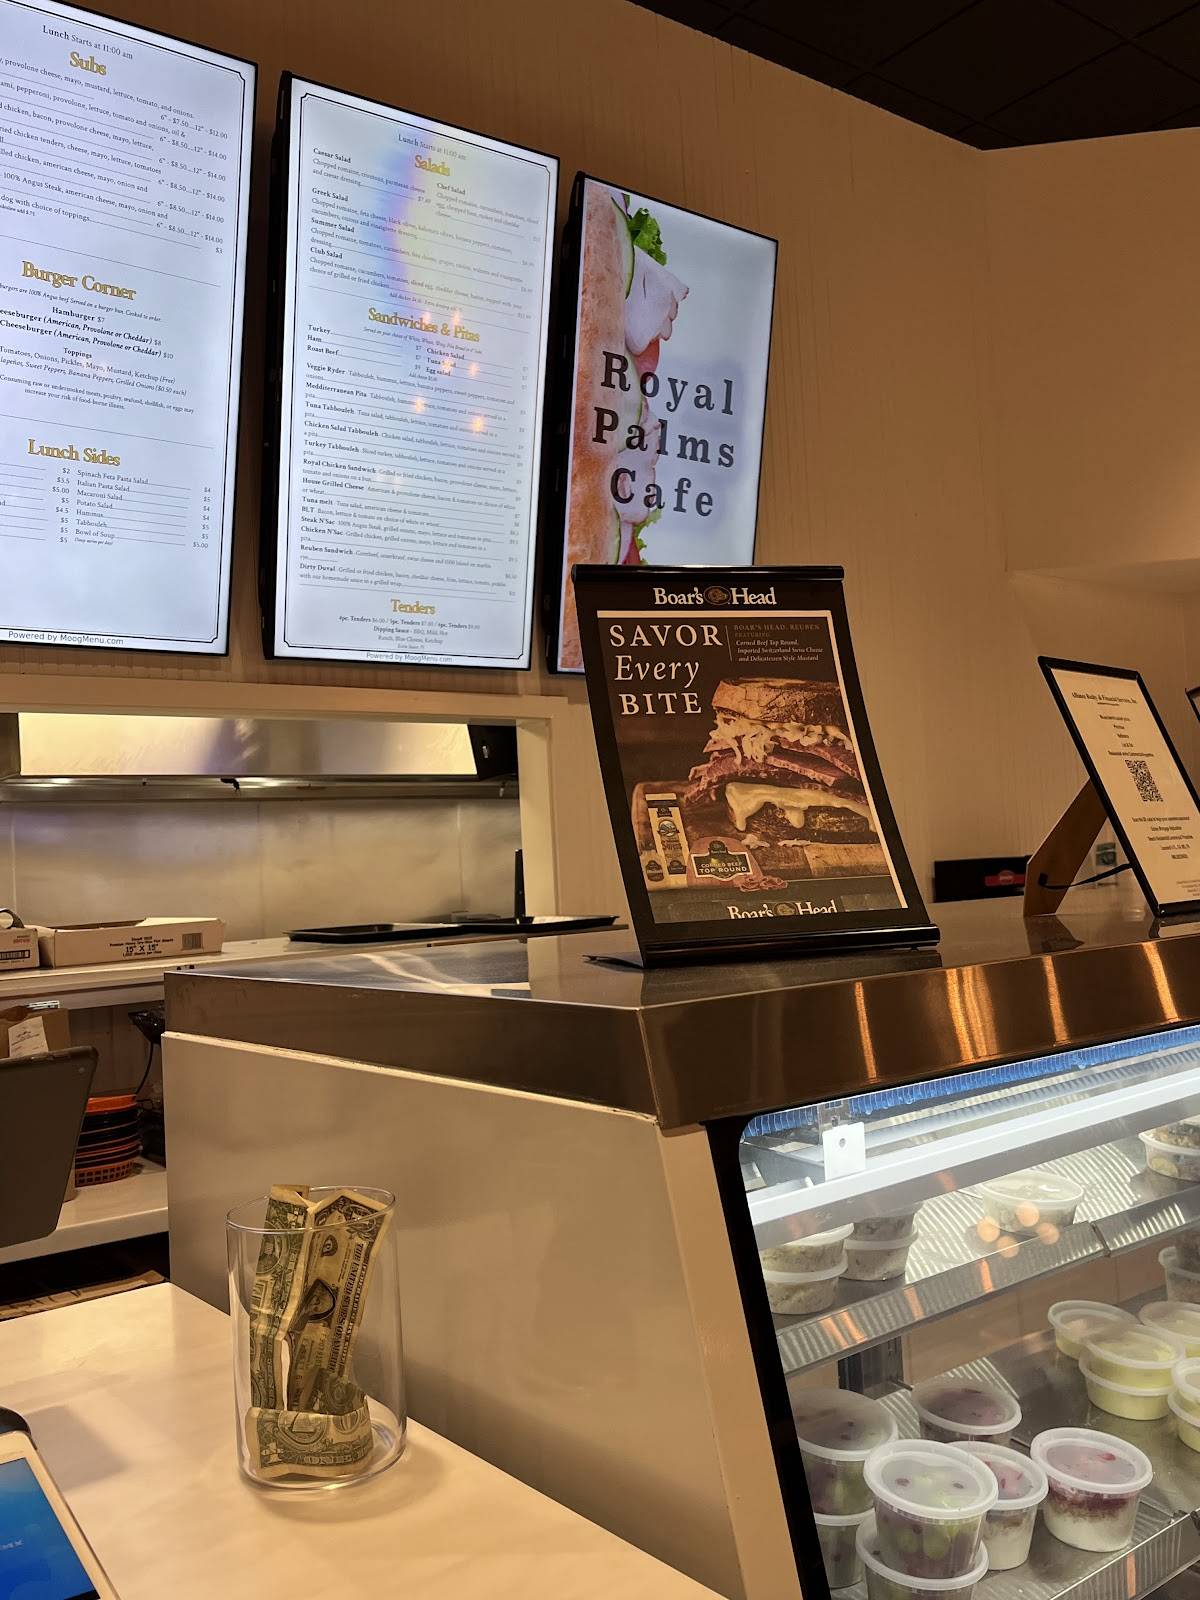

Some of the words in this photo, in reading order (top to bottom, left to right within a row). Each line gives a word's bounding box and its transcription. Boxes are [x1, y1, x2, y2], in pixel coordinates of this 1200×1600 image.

[42, 25, 69, 40] Lunch
[71, 34, 92, 47] Starts
[102, 44, 121, 56] 11:00
[4, 58, 38, 73] provolone
[69, 49, 107, 76] Subs
[55, 118, 88, 132] provolone
[398, 134, 419, 146] Lunch
[13, 129, 39, 141] chicken
[134, 162, 161, 174] tomatoes
[313, 147, 334, 158] Caesar
[334, 153, 352, 163] Salad
[414, 153, 451, 177] Salads
[43, 160, 72, 172] american
[117, 180, 135, 189] onion
[22, 176, 42, 187] Angus
[65, 189, 94, 200] american
[138, 207, 156, 216] onion
[312, 187, 331, 197] Greek
[332, 192, 349, 202] Salad
[1, 194, 15, 205] dog
[15, 199, 31, 207] with
[31, 202, 53, 212] choice
[310, 216, 338, 228] Summer
[338, 223, 355, 233] Salad
[310, 246, 326, 255] Club
[326, 250, 342, 259] Salad
[21, 260, 78, 289] Burger
[81, 274, 137, 301] Corner
[52, 307, 95, 321] Hamburger
[42, 316, 81, 331] (American,
[82, 324, 114, 336] Provolone
[122, 332, 152, 345] Cheddar)
[307, 324, 331, 335] Turkey
[368, 306, 438, 334] Sandwiches
[440, 322, 450, 336] &
[453, 324, 480, 342] Pitas
[0, 319, 52, 336] Cheeseburger
[53, 330, 91, 344] (American,
[92, 338, 123, 349] Provolone
[132, 345, 162, 357] Cheddar)
[307, 334, 322, 342] Ham
[63, 348, 92, 359] Toppings
[306, 344, 324, 353] Roast
[325, 348, 339, 356] Beef
[426, 347, 450, 357] Chicken
[34, 352, 60, 364] Onions,
[60, 357, 83, 368] Pickles,
[85, 362, 105, 373] Mayo,
[106, 366, 133, 378] Mustard,
[134, 371, 159, 382] Ketchup
[306, 362, 326, 372] Veggie
[327, 366, 346, 375] Ryder
[600, 350, 734, 415] Royal
[305, 400, 321, 408] Tuna
[322, 403, 354, 414] Tabbouleh
[304, 419, 329, 429] Chicken
[329, 423, 347, 431] Salad
[348, 426, 379, 436] Tabbouleh
[592, 406, 734, 468] Palms
[27, 438, 81, 461] Lunch
[82, 446, 121, 467] Sides
[304, 439, 326, 449] Turkey
[328, 443, 360, 453] Tabbouleh
[77, 469, 102, 478] Spinach
[303, 458, 321, 466] Royal
[321, 460, 346, 469] Chicken
[347, 464, 377, 474] Sandwich
[322, 479, 344, 488] Grilled
[344, 482, 365, 490] Cheese
[610, 468, 713, 517] Cafe
[76, 489, 106, 498] Macaroni
[100, 531, 115, 540] Soup
[300, 525, 326, 533] Chicken
[324, 547, 353, 555] Sandwich
[653, 588, 703, 605] Boar's
[730, 587, 777, 605] Head
[390, 598, 436, 615] Tenders
[8, 631, 45, 641] Powered
[48, 633, 58, 643] by
[60, 634, 124, 646] MoogMenu.com
[610, 625, 723, 647] SAVOR
[366, 652, 390, 660] Powered
[393, 654, 402, 662] by
[404, 654, 452, 662] MoogMenu.com
[614, 655, 699, 688] Every
[619, 692, 702, 715] BITE
[727, 906, 773, 919] Boar's
[797, 900, 837, 914] Head
